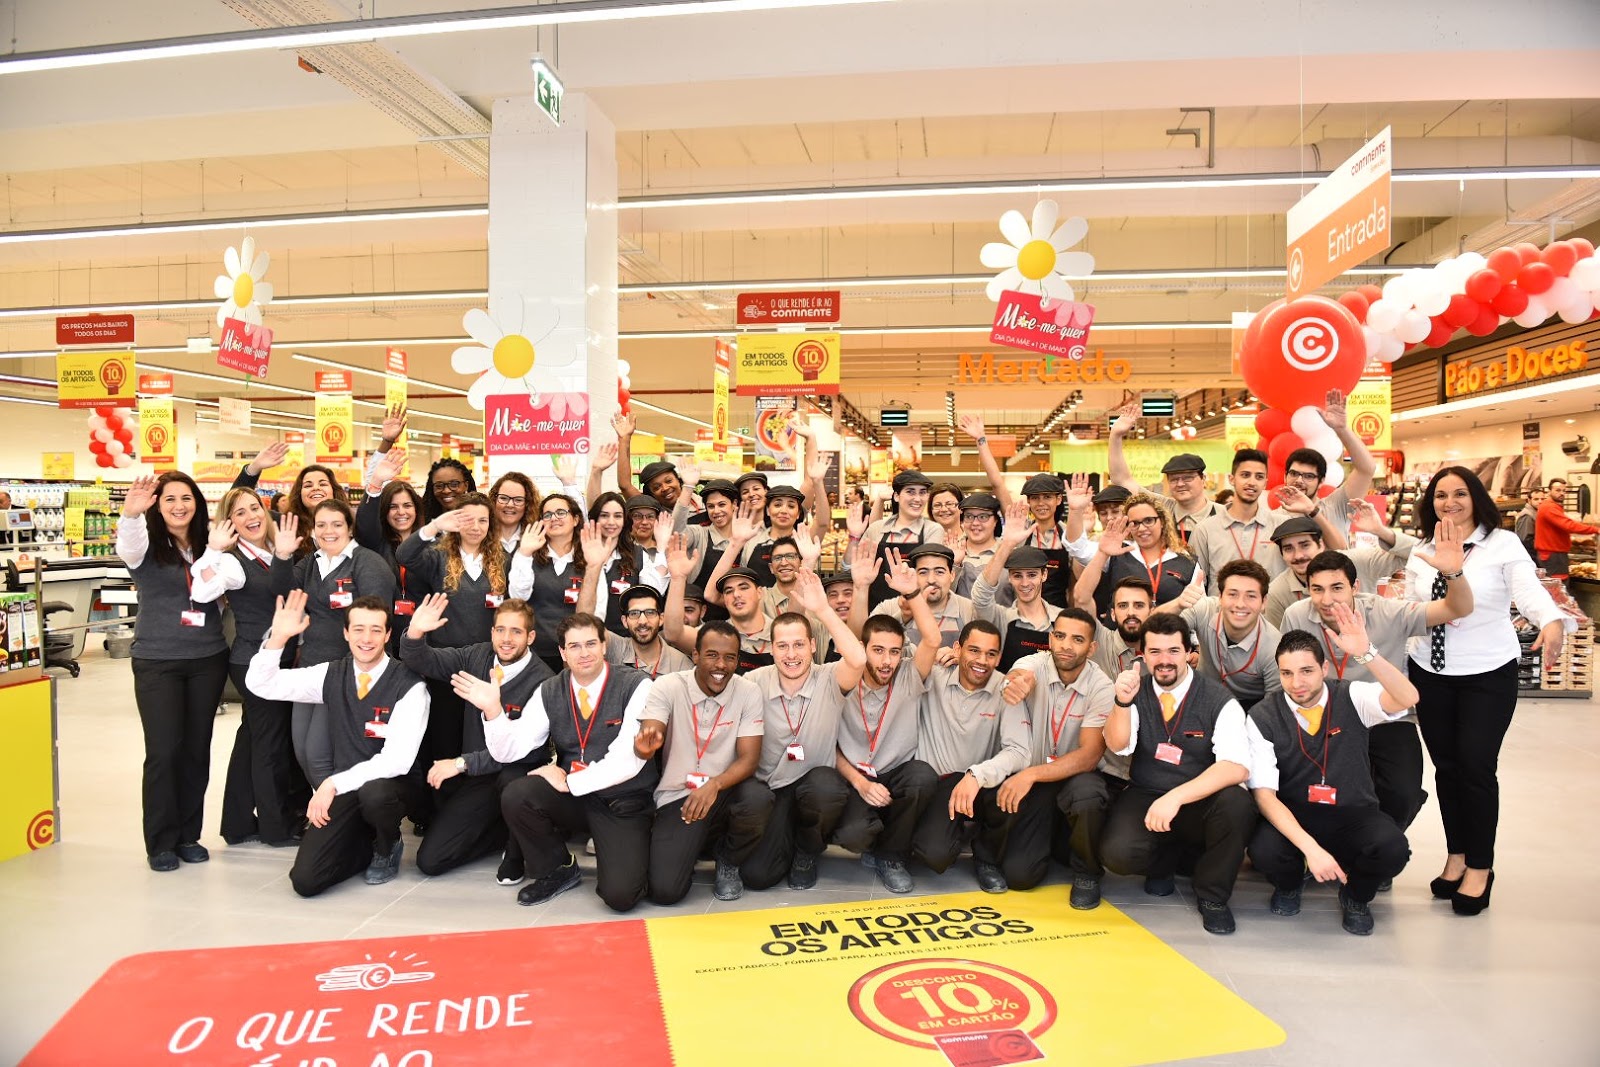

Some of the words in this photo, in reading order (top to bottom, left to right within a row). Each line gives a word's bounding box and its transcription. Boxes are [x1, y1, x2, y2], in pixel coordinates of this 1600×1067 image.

[1328, 197, 1386, 264] Entrada
[771, 299, 776, 309] O
[777, 299, 789, 309] QUE
[791, 298, 809, 308] RENDE
[817, 298, 823, 307] IR
[824, 298, 832, 307] AO
[771, 308, 832, 317] CONTINENTE
[995, 333, 1005, 341] DIA
[1016, 337, 1030, 347] MÃE
[1039, 342, 1048, 350] DE
[1049, 344, 1067, 354] MAIO
[754, 359, 788, 367] ARTIGOS
[958, 348, 1132, 385] Mercado
[1446, 360, 1485, 397] Pão
[1487, 362, 1504, 387] e
[1507, 340, 1589, 383] Doces
[760, 938, 828, 957] OS
[840, 919, 1035, 951] ARTIGOS
[769, 920, 839, 939] EM
[845, 906, 1002, 931] TODOS
[695, 966, 736, 974] EXCETO
[868, 949, 923, 958] LACTENTES
[1064, 930, 1110, 938] PRESENTE
[892, 973, 977, 988] DESCONTO
[900, 982, 1020, 1018] 10%
[168, 1017, 214, 1053] O
[236, 1008, 343, 1051] QUE
[367, 993, 533, 1038] RENDE
[918, 1019, 944, 1030] EM
[948, 1012, 1015, 1027] CARTÃO
